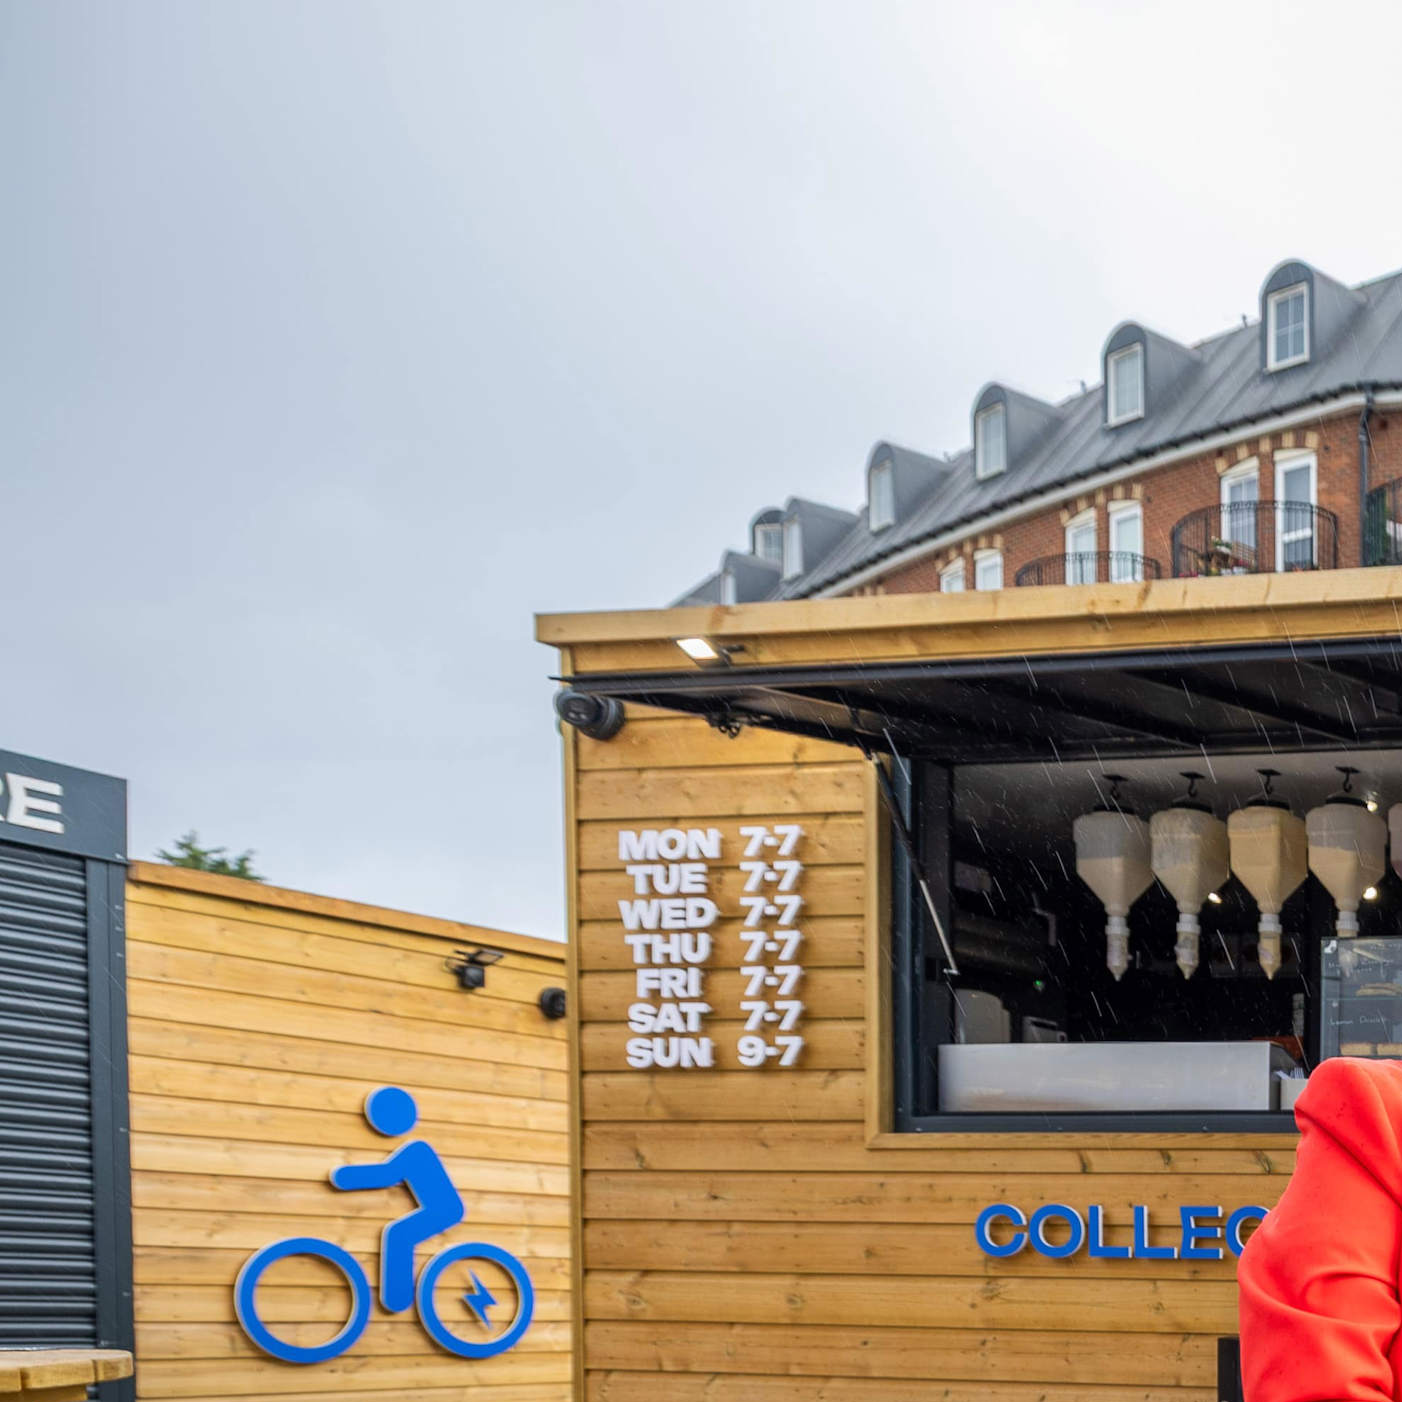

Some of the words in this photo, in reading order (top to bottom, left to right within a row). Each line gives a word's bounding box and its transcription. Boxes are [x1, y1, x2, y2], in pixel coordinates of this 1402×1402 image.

[0, 772, 65, 834] E
[618, 827, 722, 861] MON
[739, 824, 804, 857] 7-7
[625, 863, 709, 895] TUE
[739, 860, 804, 892] 7-7
[618, 897, 720, 930] WED
[739, 895, 804, 927] 7-7
[624, 932, 713, 964] THU
[739, 930, 804, 962] 7-7
[636, 966, 703, 998] FRI
[739, 965, 804, 996] 7-7
[627, 1001, 712, 1033] SAT
[739, 1000, 804, 1031] 7-7
[625, 1036, 715, 1068] SUN
[737, 1035, 804, 1067] 9-7
